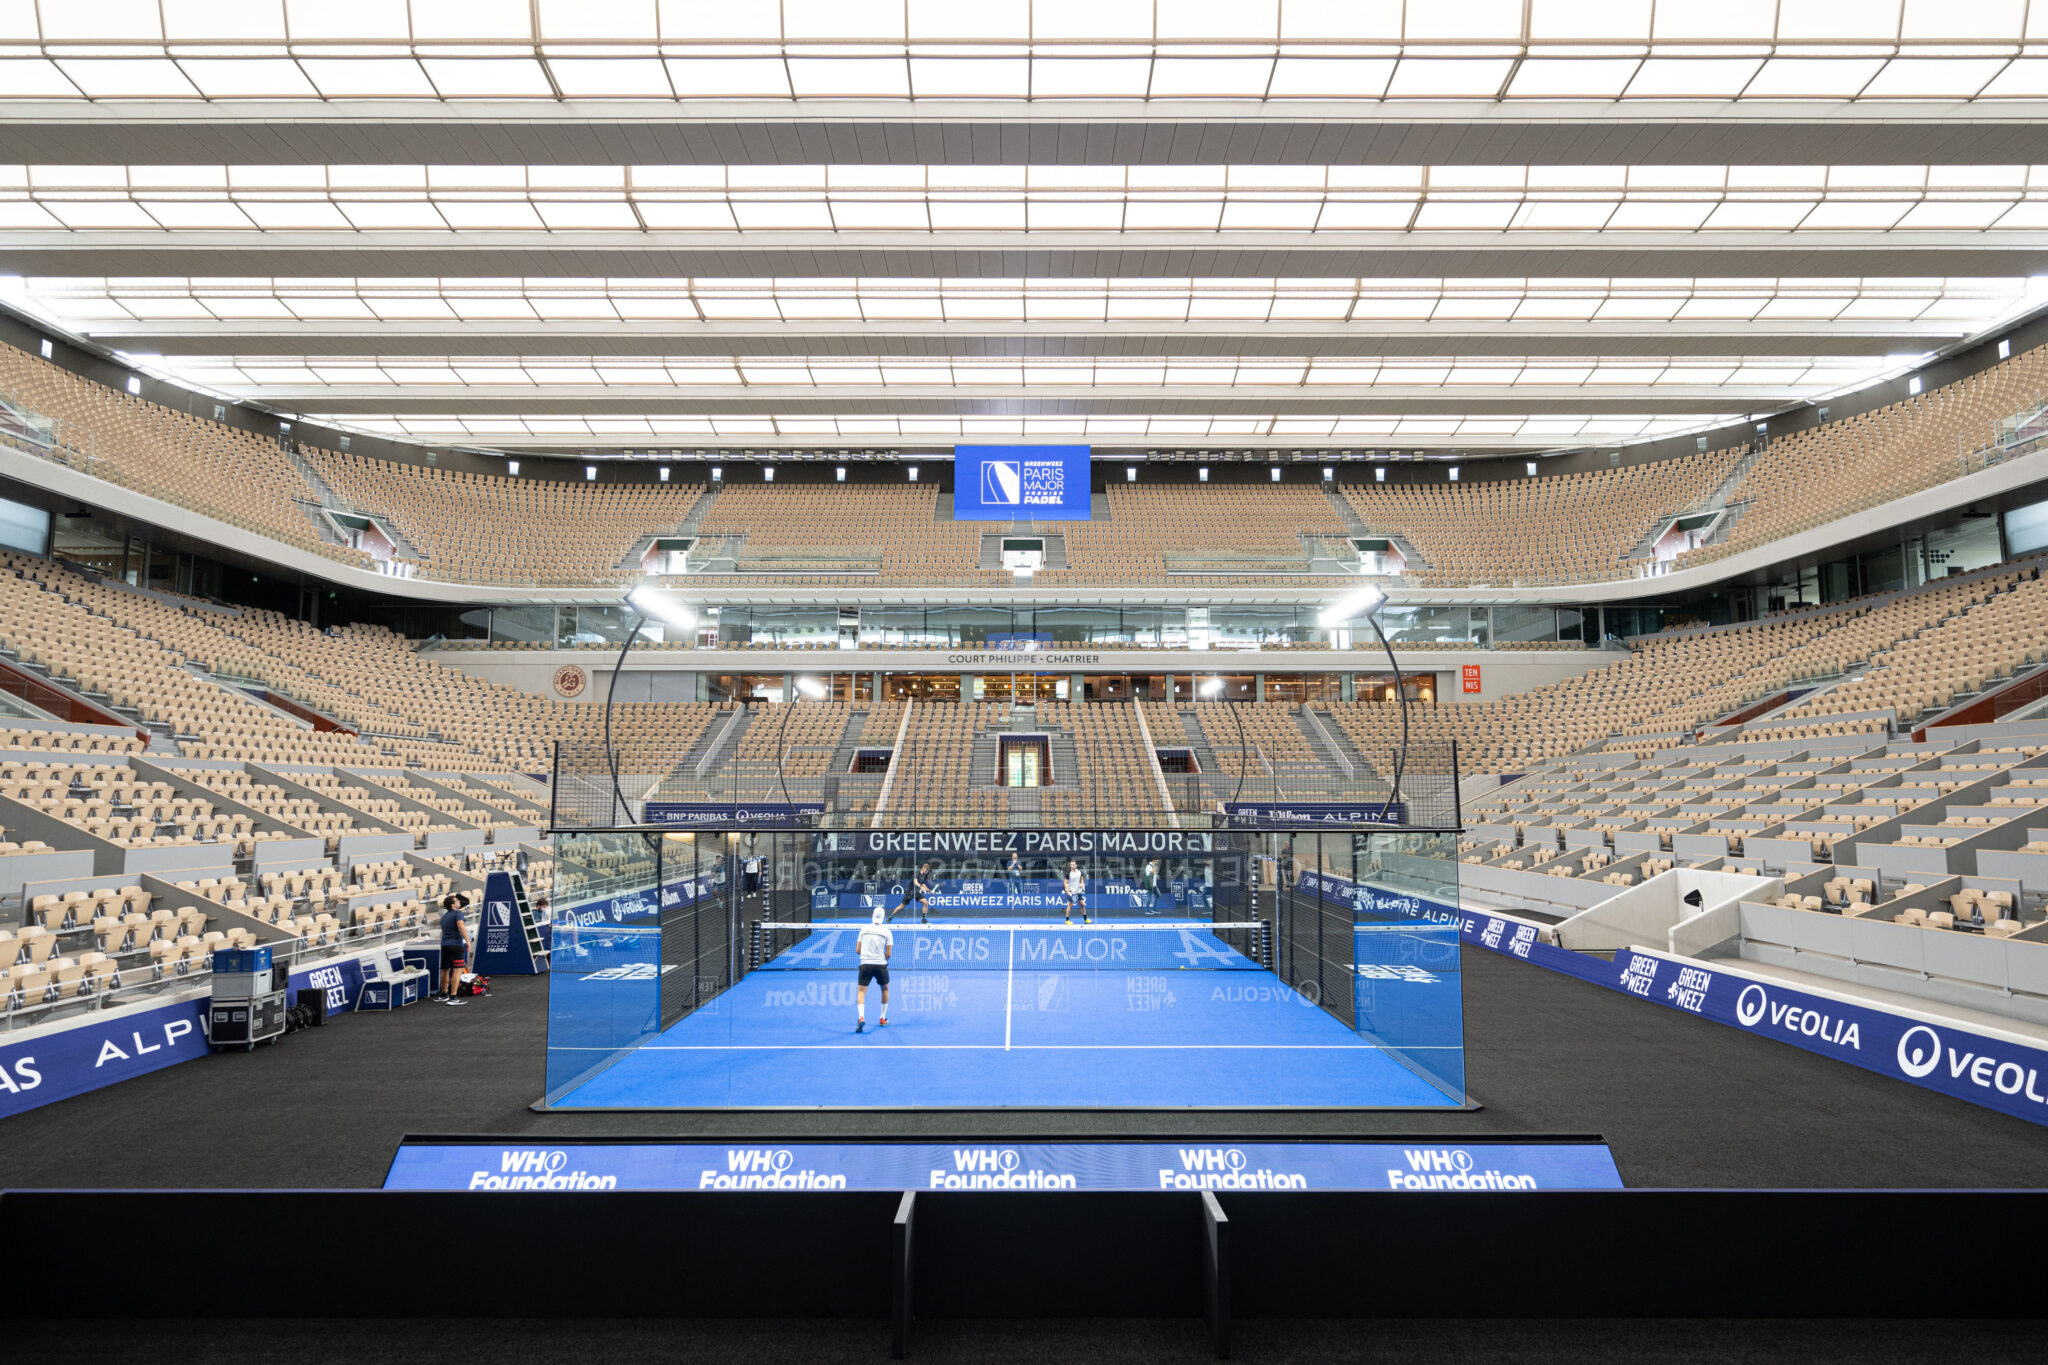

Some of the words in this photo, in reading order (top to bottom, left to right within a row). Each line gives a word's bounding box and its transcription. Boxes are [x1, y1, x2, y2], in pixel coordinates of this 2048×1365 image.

[1024, 468, 1064, 480] PARIS
[1024, 481, 1064, 490] MAJOR
[1024, 496, 1063, 504] PADEL
[949, 655, 984, 663] COURT
[989, 655, 1036, 663] PHILIPPE
[1046, 655, 1099, 663] CHATRIER
[1466, 681, 1479, 689] NIS
[1324, 812, 1398, 821] ALPINE
[869, 832, 1017, 851] GREENWEEZ
[1026, 832, 1093, 851] PARIS
[1102, 832, 1183, 851] MAJOR
[963, 883, 983, 891] GREEN
[928, 896, 1003, 906] GREENWEEZ
[1007, 896, 1041, 906] PARIS
[577, 909, 606, 926] VEOLIA
[1422, 910, 1475, 933] ALPINE
[1488, 918, 1506, 935] GREEN
[488, 932, 509, 940] PARIS
[1485, 931, 1501, 949] WEEZ
[1516, 925, 1536, 943] GREEN
[914, 937, 990, 960] PARIS
[1020, 938, 1127, 961] MAJOR
[1514, 939, 1531, 958] WEEZ
[1630, 955, 1658, 978] GREEN
[309, 966, 343, 990] GREEN
[1627, 973, 1653, 997] WEEZ
[1678, 967, 1711, 993] GREEN
[327, 985, 349, 1009] EEZ
[1677, 988, 1706, 1013] WEEZ
[1771, 1001, 1860, 1050] VEOLIA
[1948, 1048, 2048, 1104] VEOL
[501, 1151, 567, 1173] WHO
[728, 1150, 793, 1171] WHO
[954, 1150, 1019, 1171] WHO
[1179, 1149, 1247, 1171] WHO
[1404, 1150, 1473, 1171] WHO
[469, 1170, 617, 1190] Foundation
[700, 1169, 846, 1189] Foundation
[930, 1169, 1076, 1189] Foundation
[1160, 1168, 1307, 1189] Foundation
[1387, 1169, 1537, 1190] Foundation
